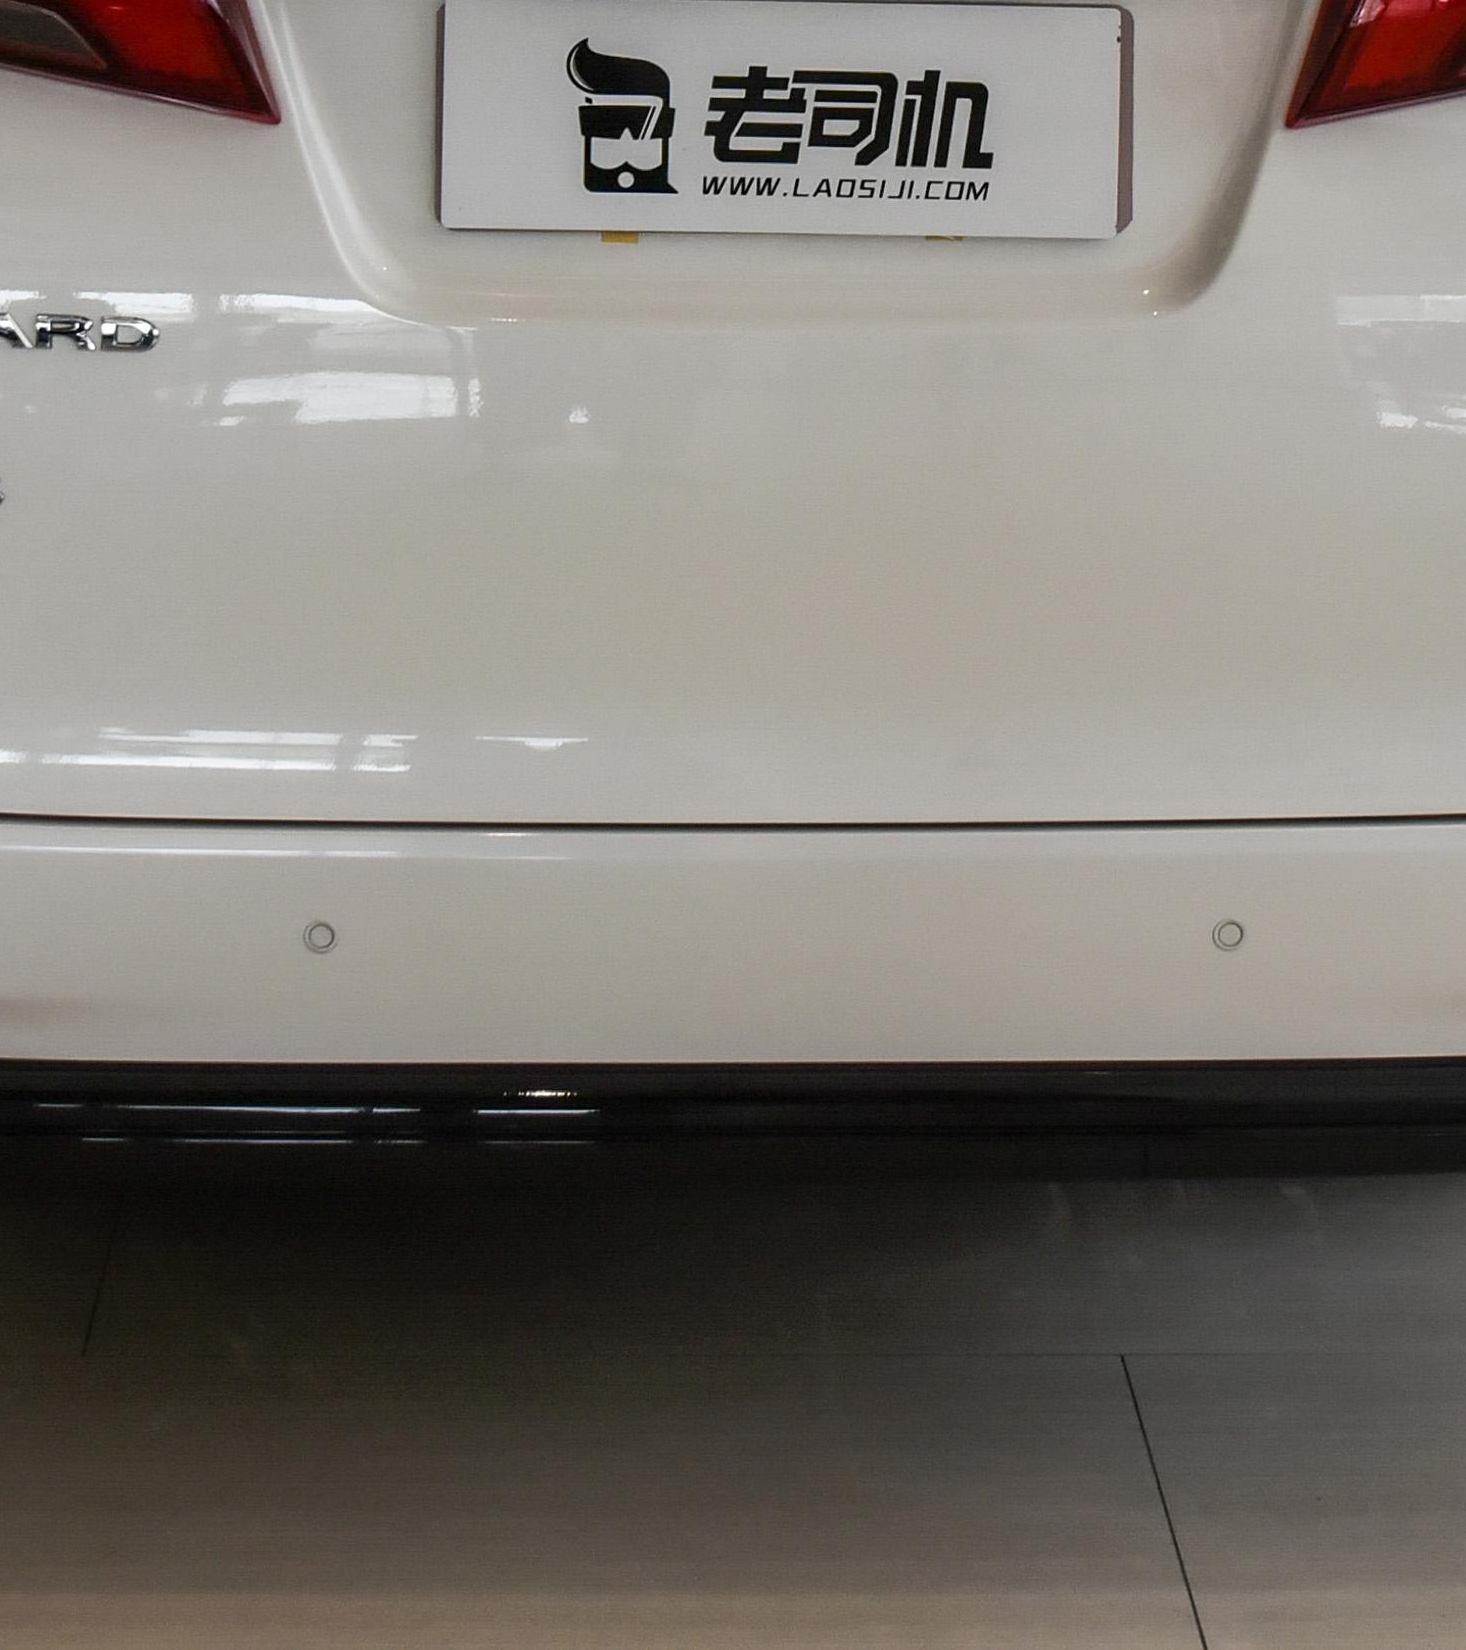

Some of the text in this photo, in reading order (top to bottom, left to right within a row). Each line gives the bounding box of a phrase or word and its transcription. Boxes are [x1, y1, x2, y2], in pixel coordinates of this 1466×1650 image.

[704, 65, 994, 169] 老司机
[702, 175, 990, 201] WWW.LAOSIJI.COM
